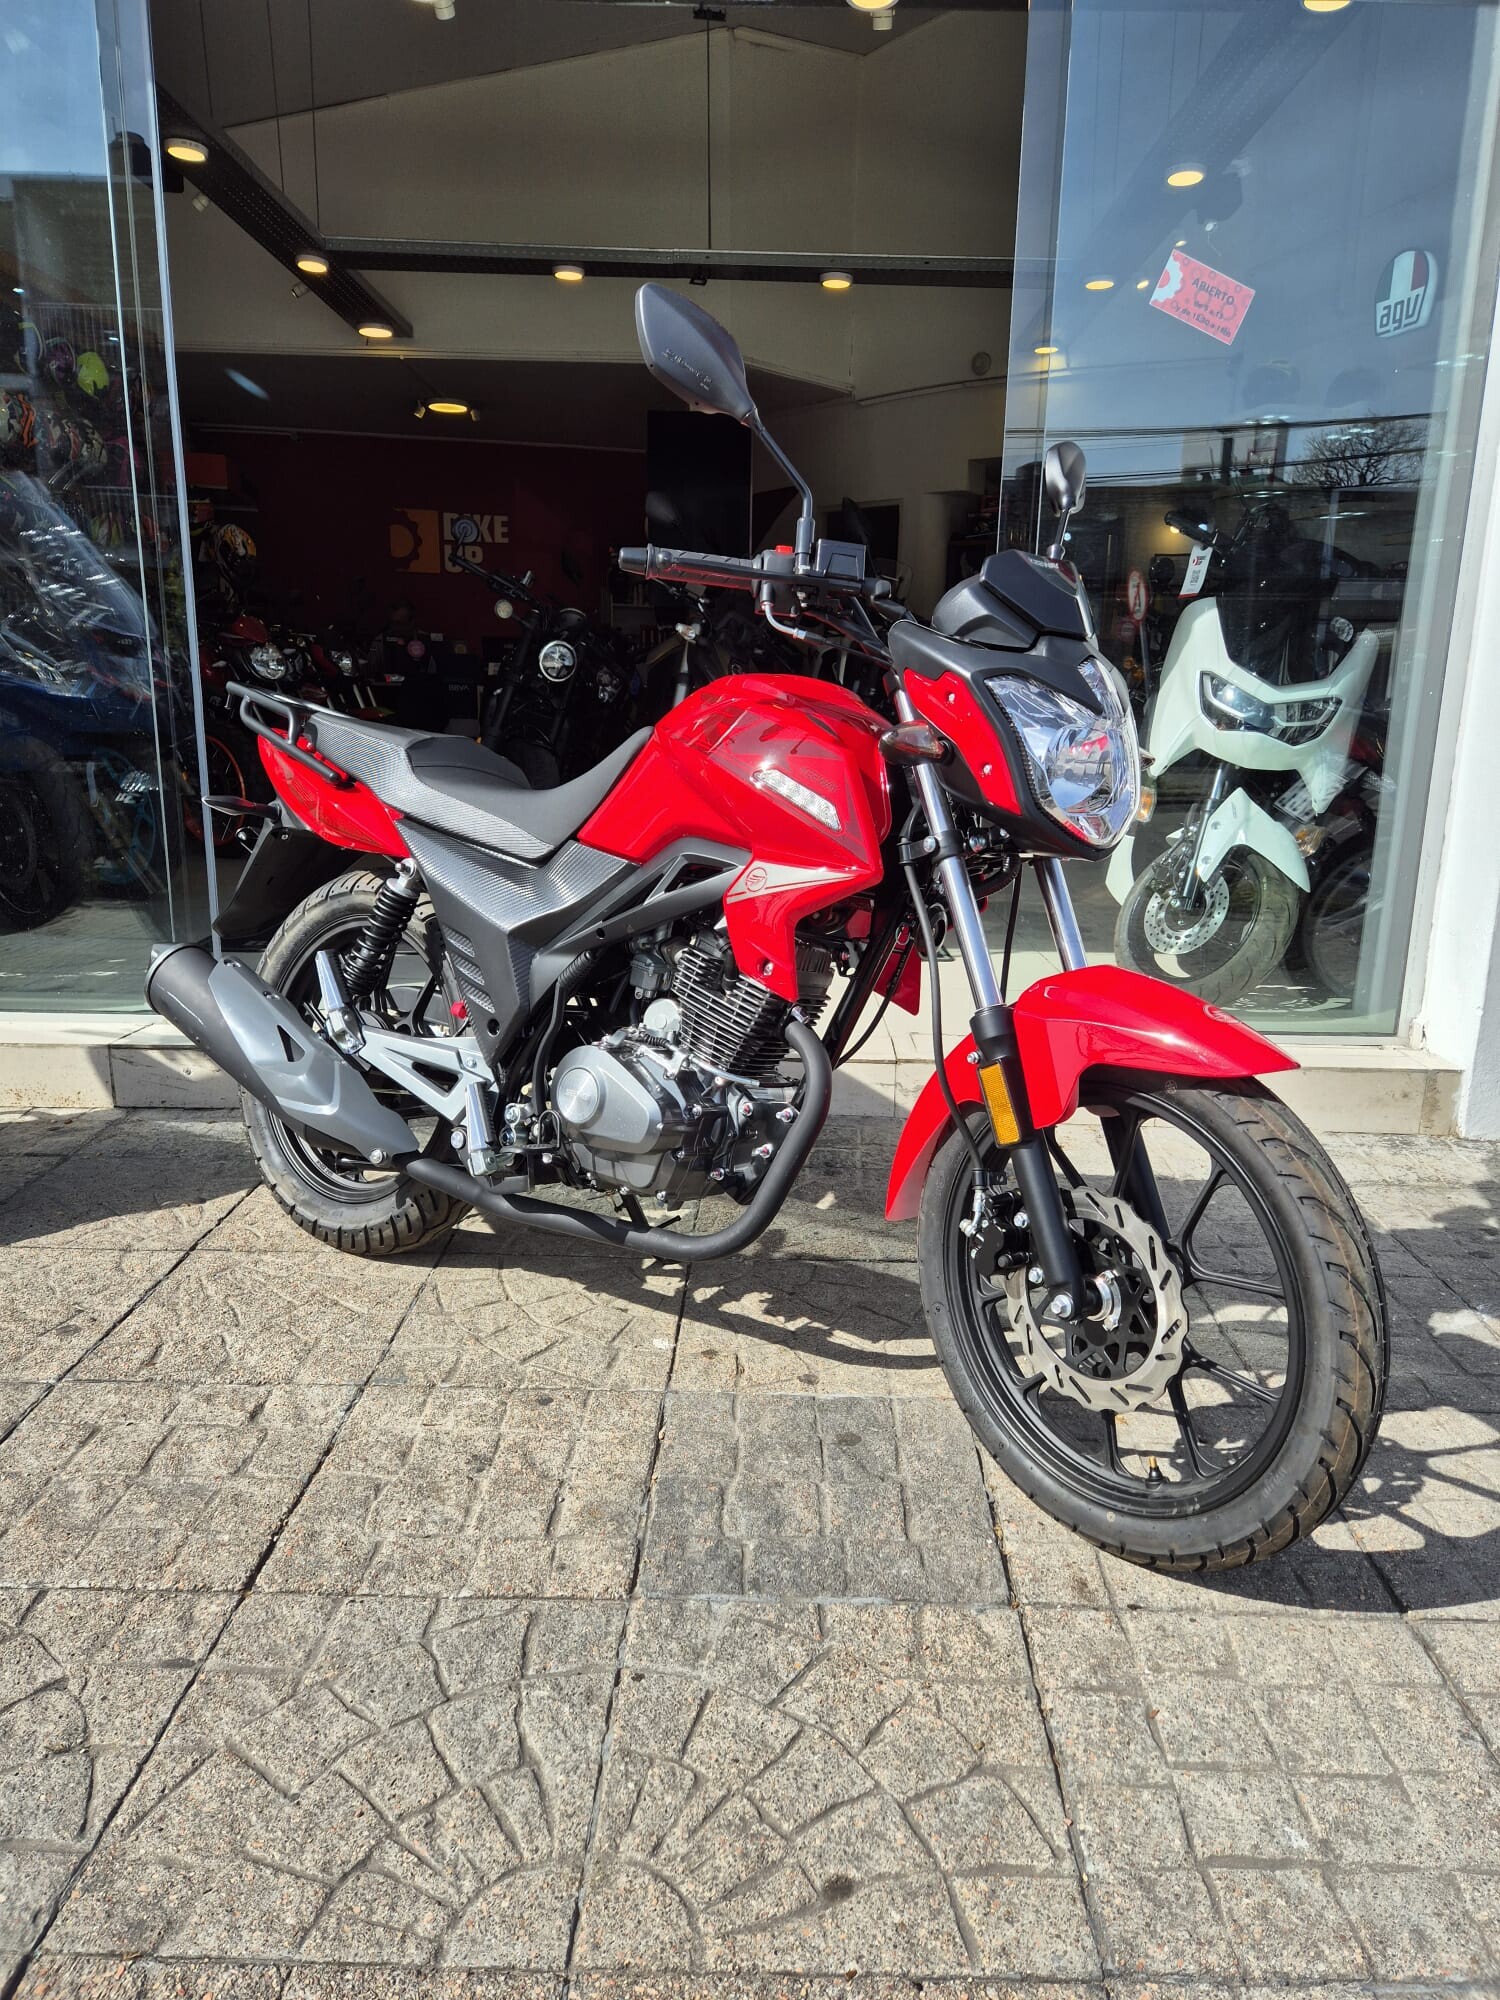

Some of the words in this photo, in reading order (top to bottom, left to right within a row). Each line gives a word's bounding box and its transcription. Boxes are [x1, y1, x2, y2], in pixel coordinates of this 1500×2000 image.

[1192, 278, 1235, 305] ABIERTO
[1379, 293, 1420, 332] agv
[443, 512, 509, 544] BKE
